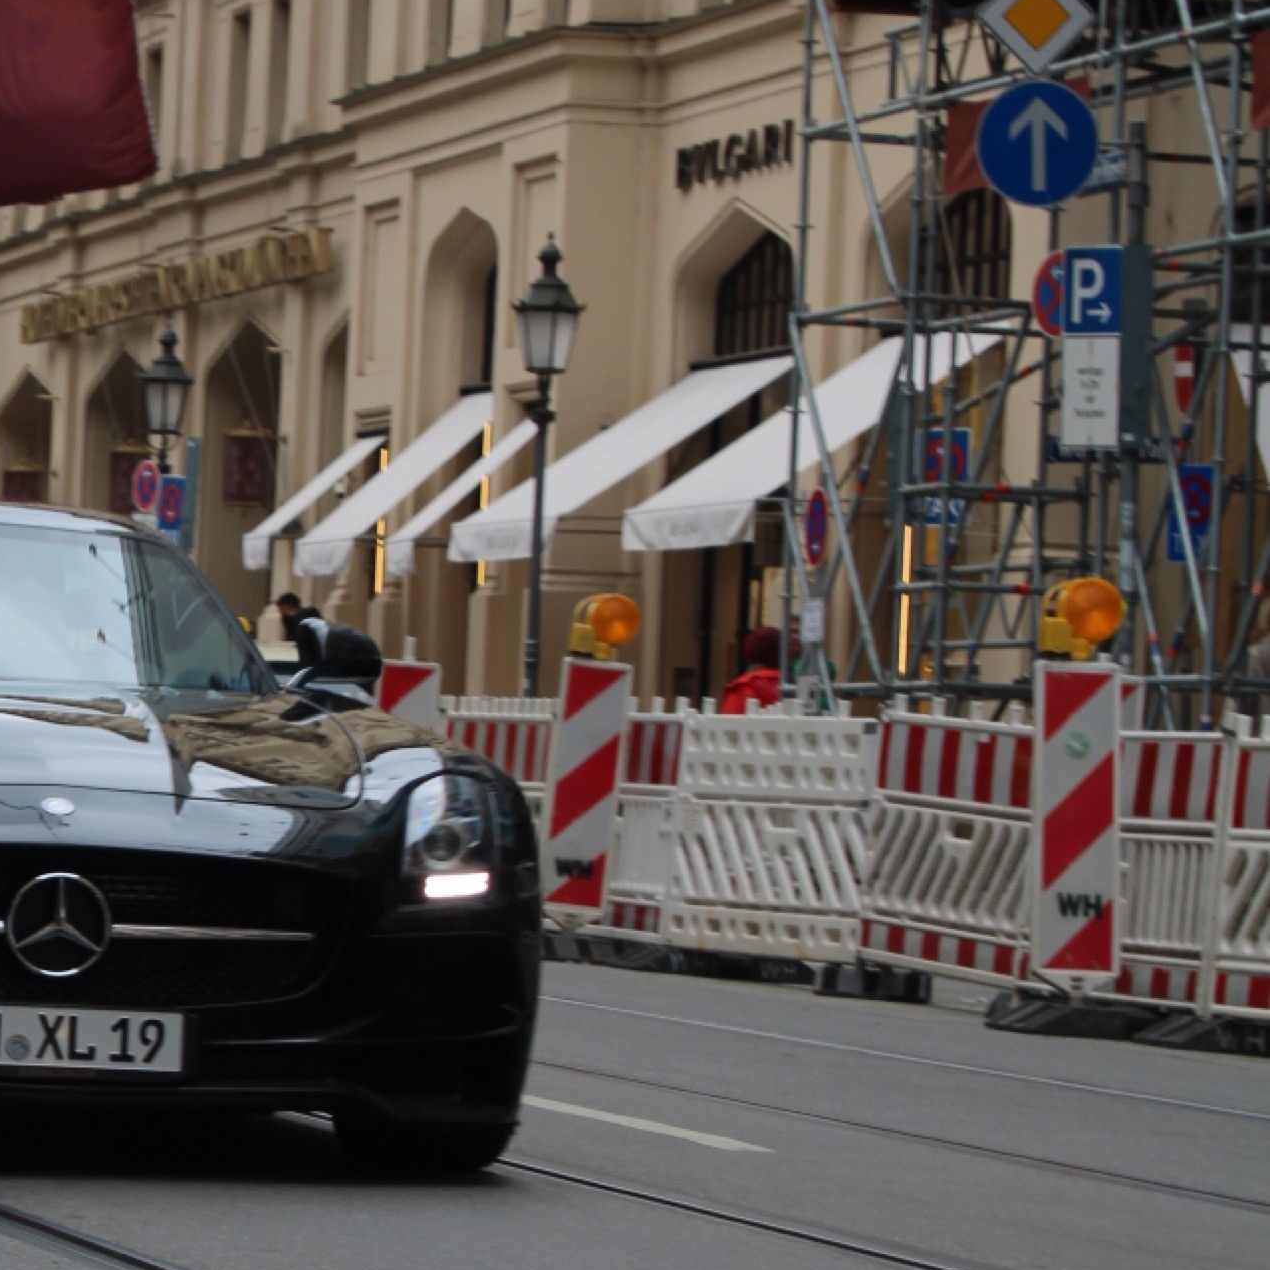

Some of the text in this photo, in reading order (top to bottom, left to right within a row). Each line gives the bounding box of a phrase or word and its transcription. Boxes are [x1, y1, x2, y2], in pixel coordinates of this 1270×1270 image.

[1070, 258, 1105, 325] P
[1057, 893, 1103, 919] WH
[35, 1014, 97, 1061] XL
[108, 1017, 166, 1064] 19
